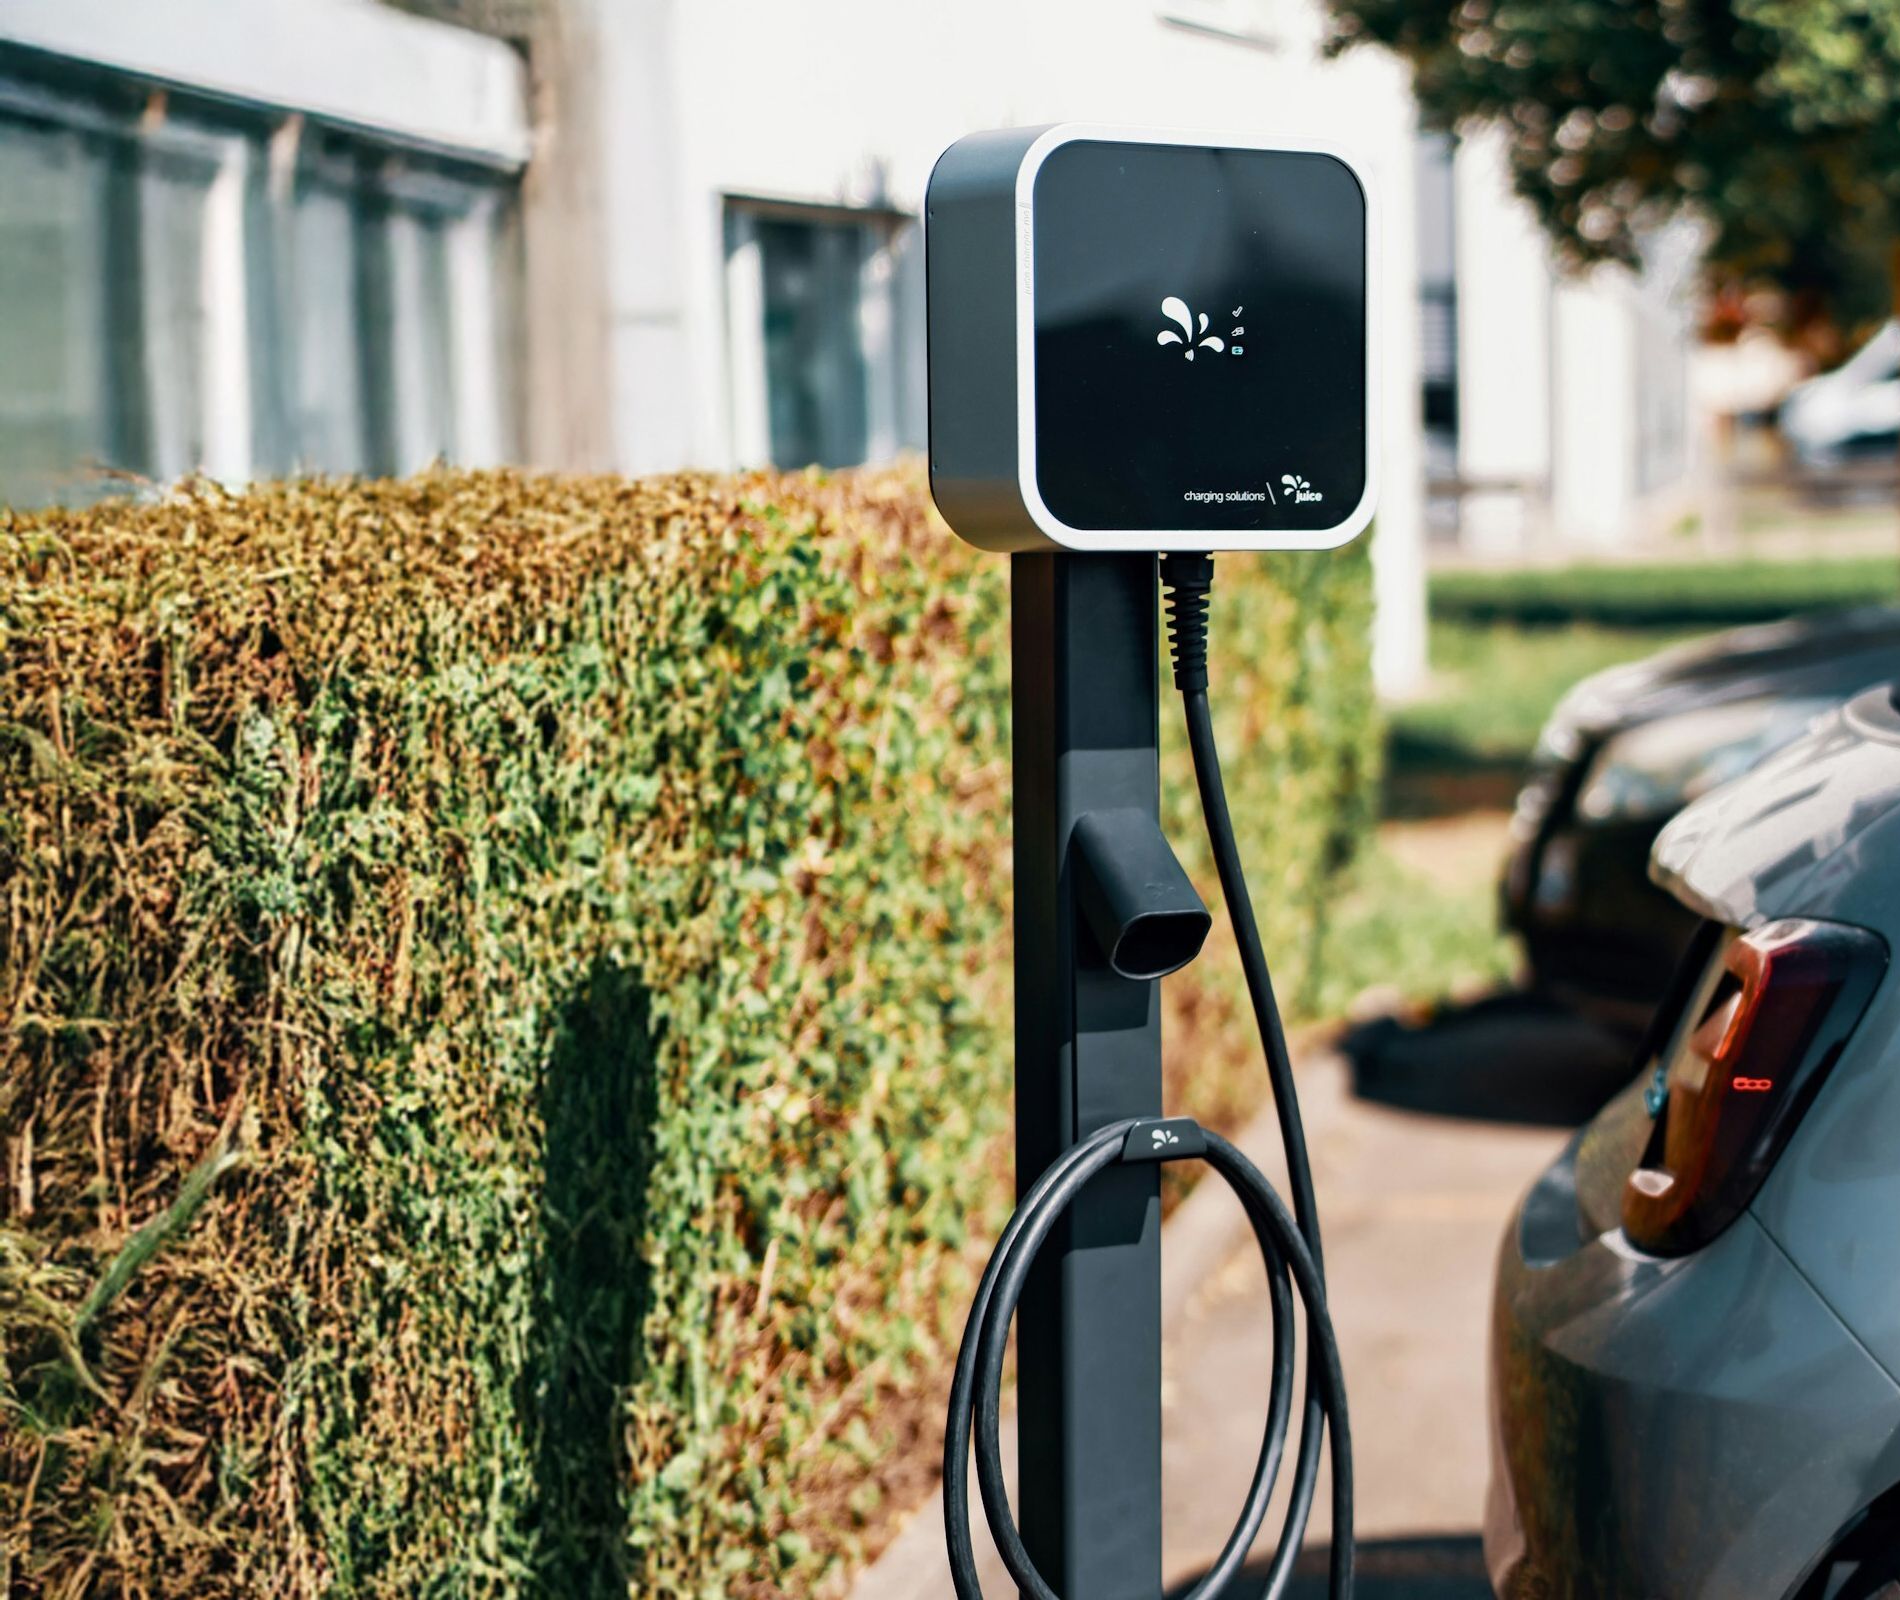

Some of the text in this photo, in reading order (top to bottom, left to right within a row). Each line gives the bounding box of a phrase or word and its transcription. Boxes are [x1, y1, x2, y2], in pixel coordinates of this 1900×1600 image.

[1184, 490, 1265, 503] charging solutions
[1295, 489, 1323, 504] juice
[1733, 1077, 1772, 1090] 500
